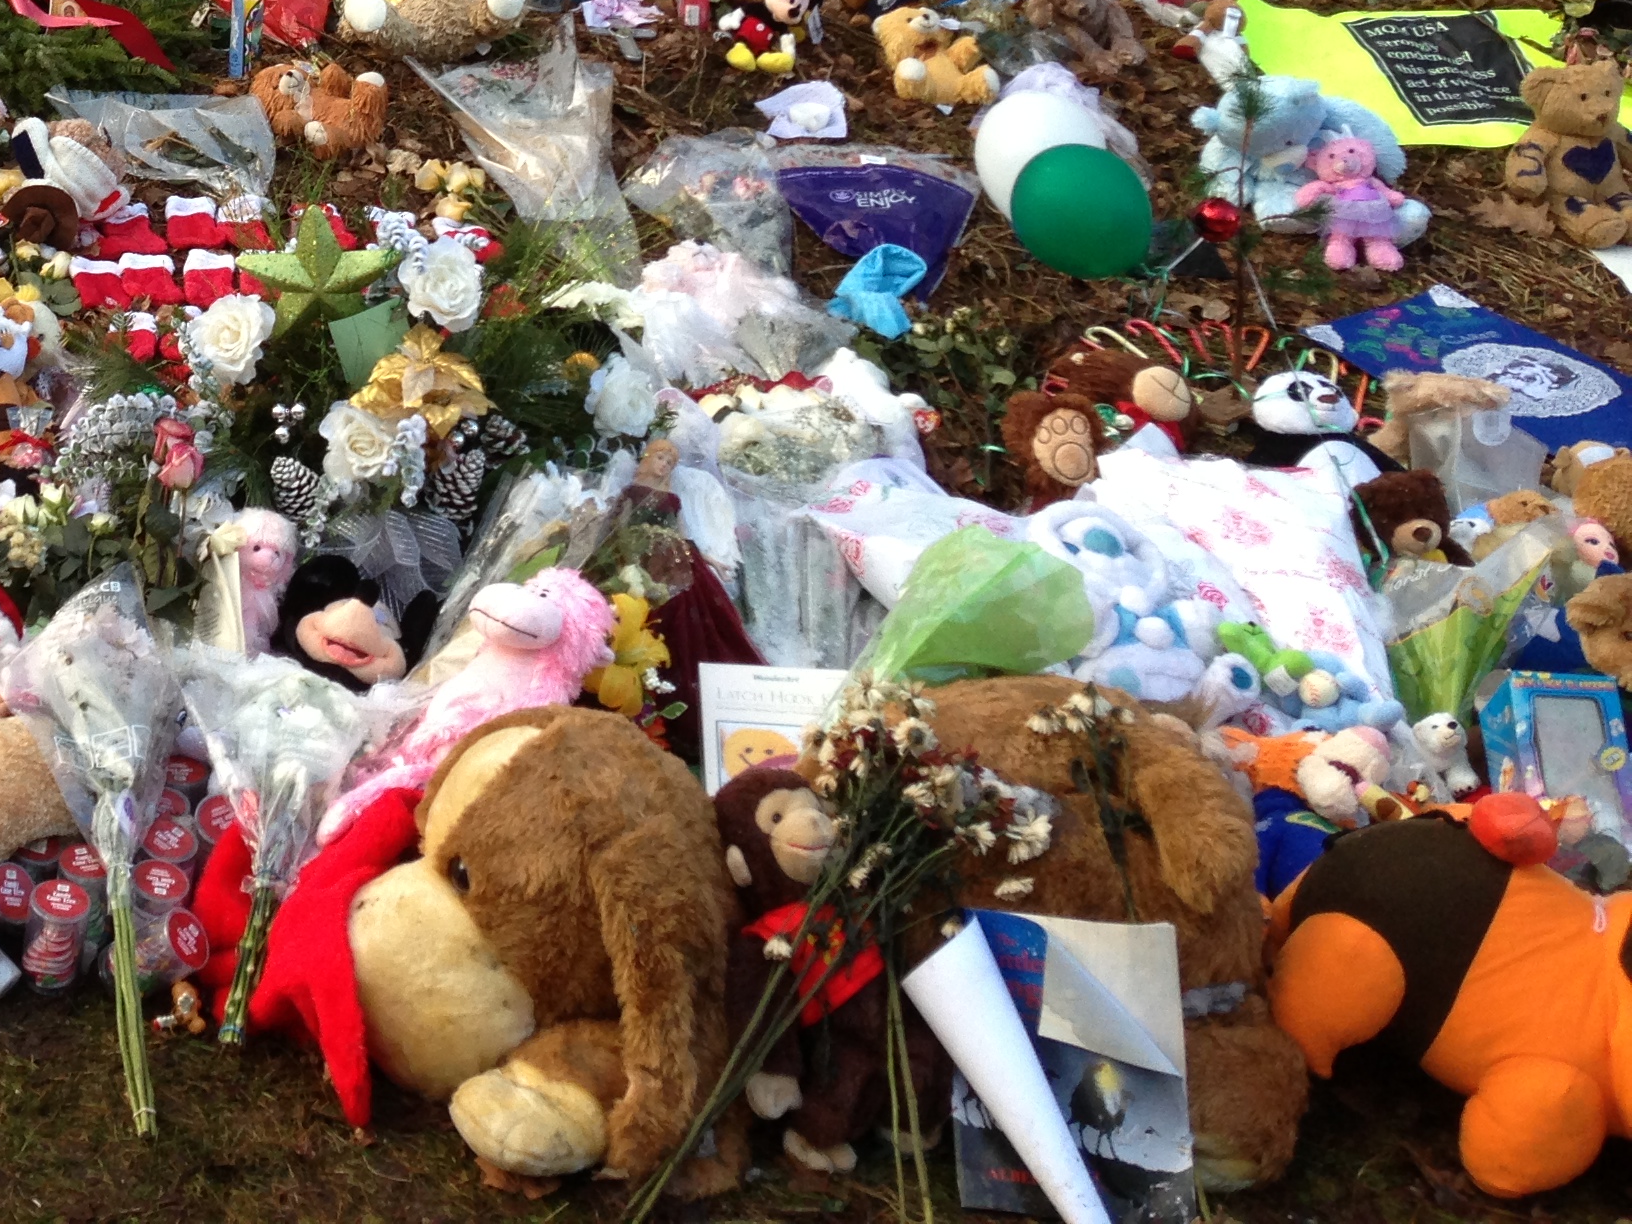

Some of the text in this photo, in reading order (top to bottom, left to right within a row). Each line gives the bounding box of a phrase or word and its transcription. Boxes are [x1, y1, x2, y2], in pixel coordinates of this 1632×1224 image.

[1412, 21, 1449, 38] USA
[1376, 38, 1439, 53] strongly
[1394, 63, 1425, 75] this
[1405, 79, 1429, 88] act
[1450, 77, 1511, 93] vice
[1413, 92, 1431, 103] in
[1434, 90, 1462, 101] the
[855, 188, 907, 200] SIMPLY
[856, 195, 917, 209] ENJOY
[716, 687, 763, 703] LATCH
[770, 690, 814, 706] HOOK
